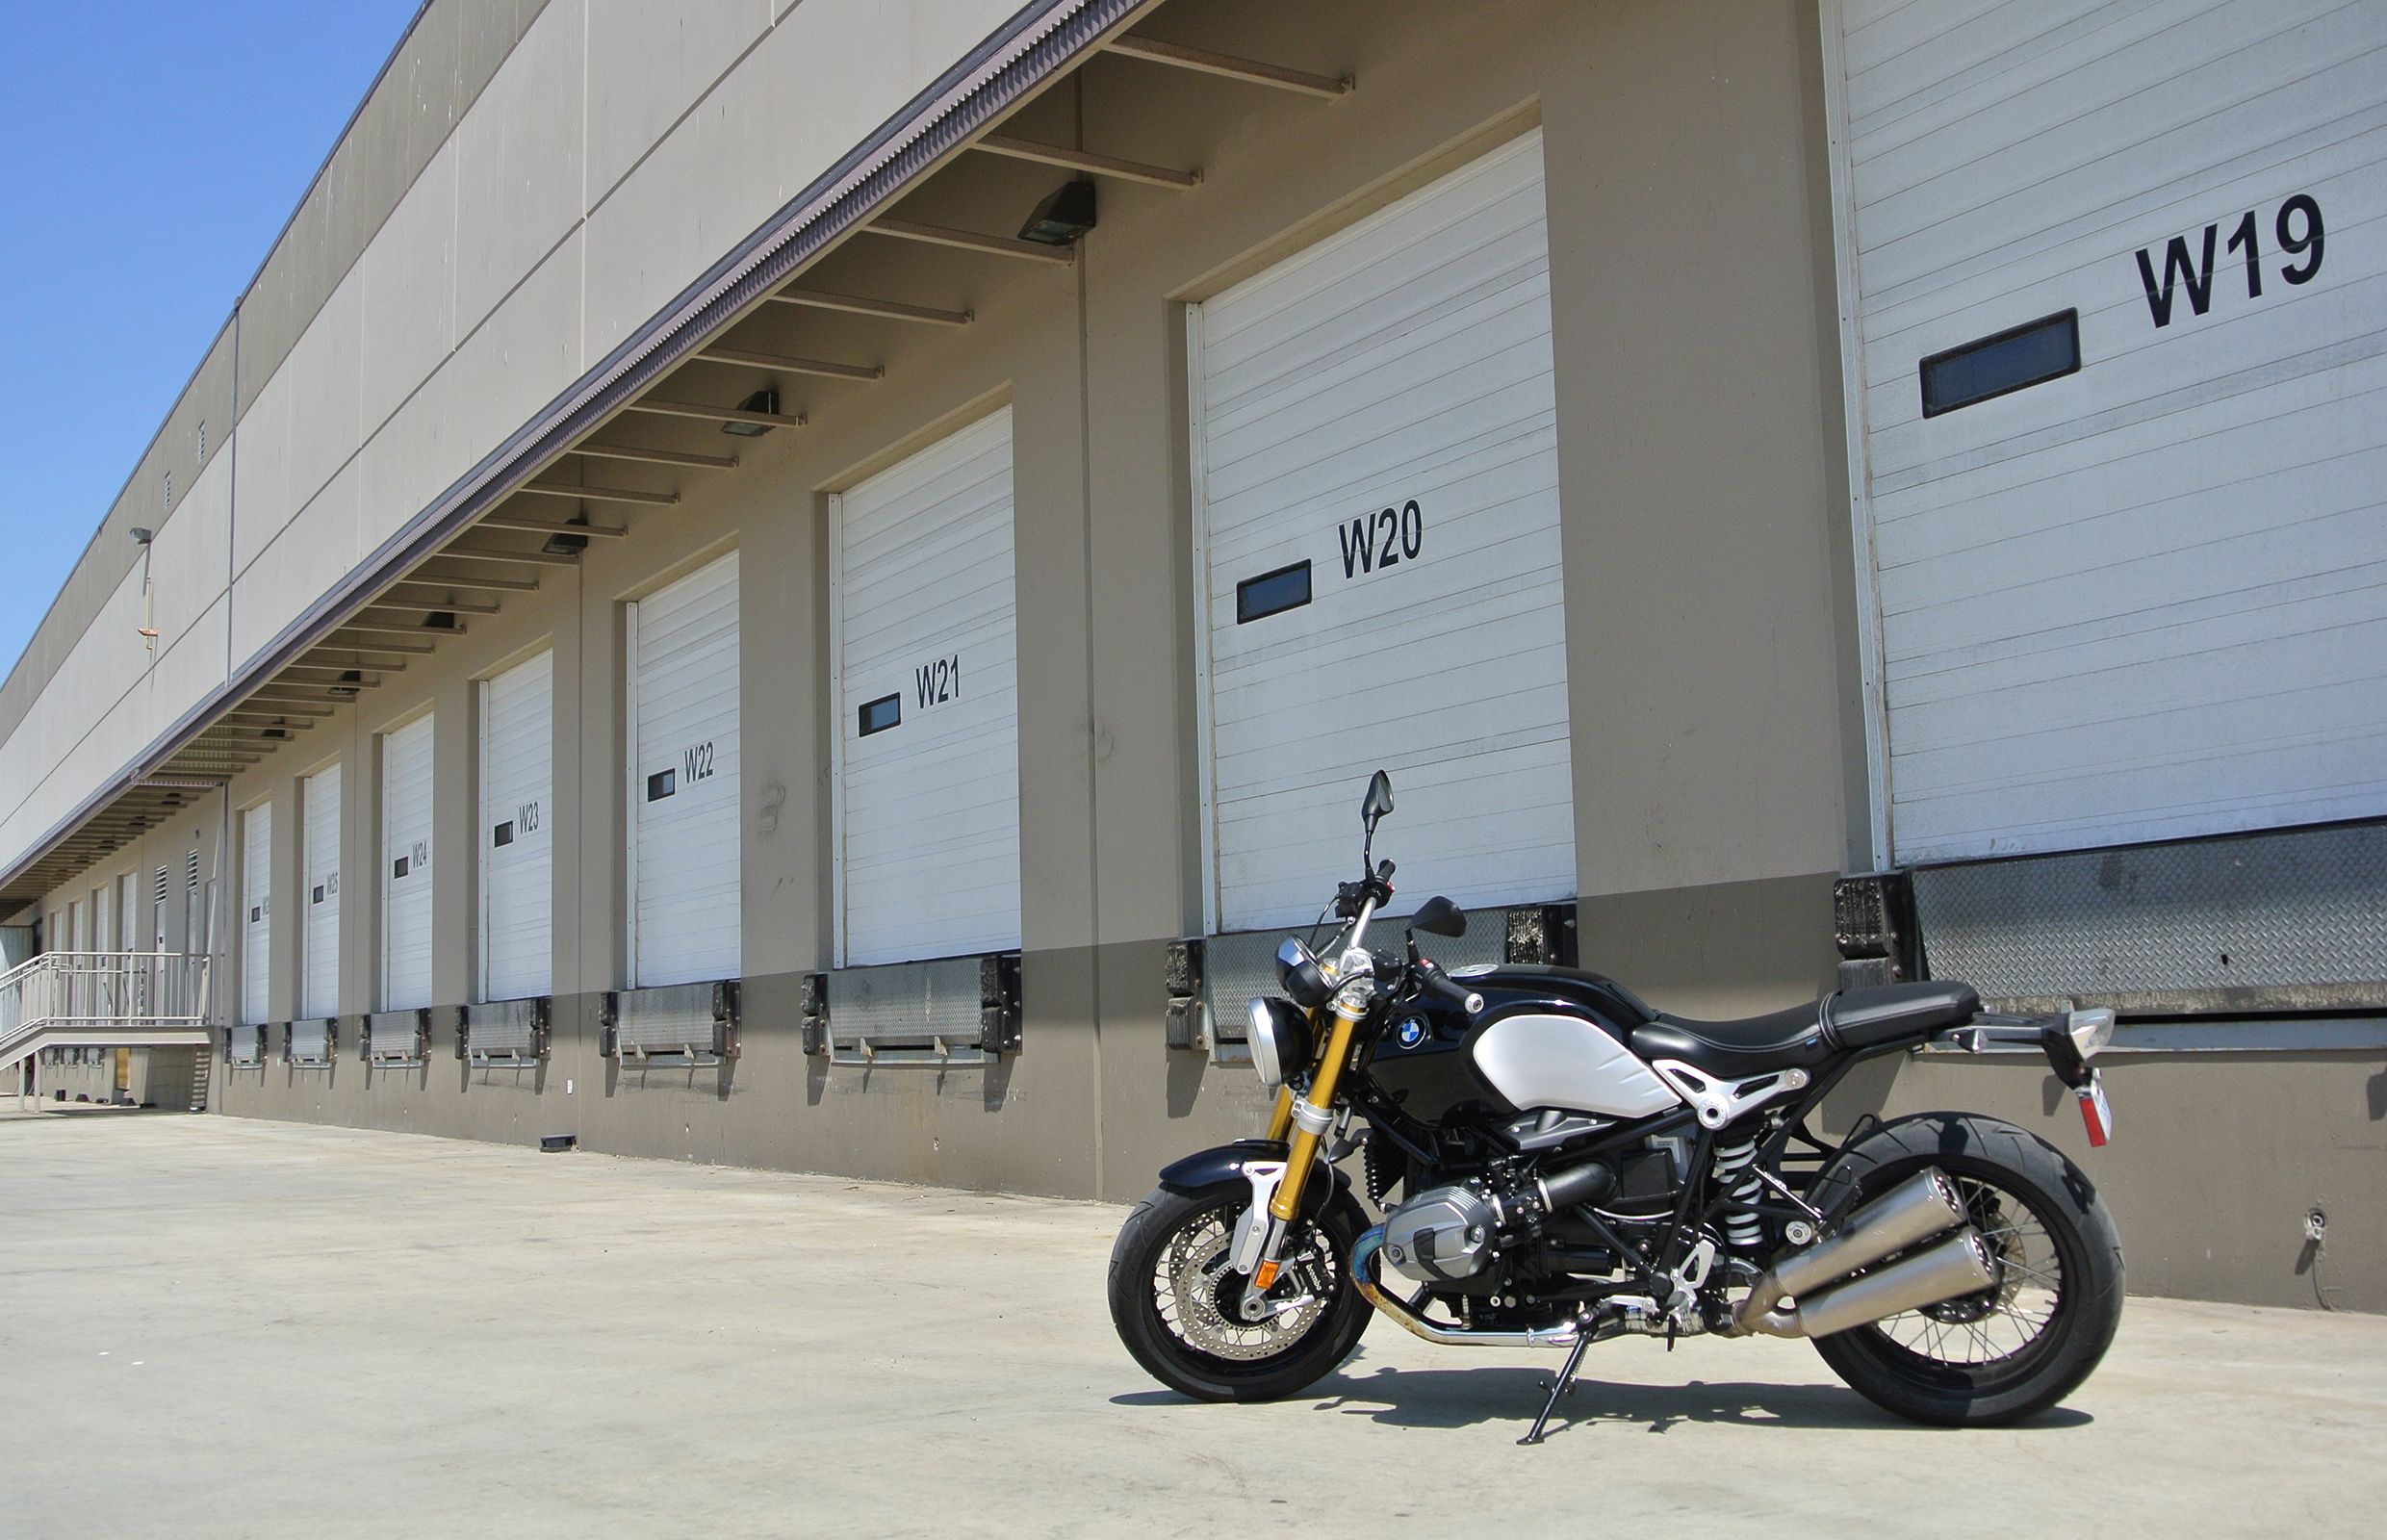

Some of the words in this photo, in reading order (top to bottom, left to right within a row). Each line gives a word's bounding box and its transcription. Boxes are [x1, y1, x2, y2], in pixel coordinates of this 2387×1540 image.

[2136, 194, 2324, 328] W19
[1339, 500, 1422, 579] W20
[916, 654, 960, 708] W21
[684, 742, 713, 783] W22
[519, 802, 539, 834] W23
[412, 840, 427, 868] W24
[1305, 1263, 1322, 1292] brembo
